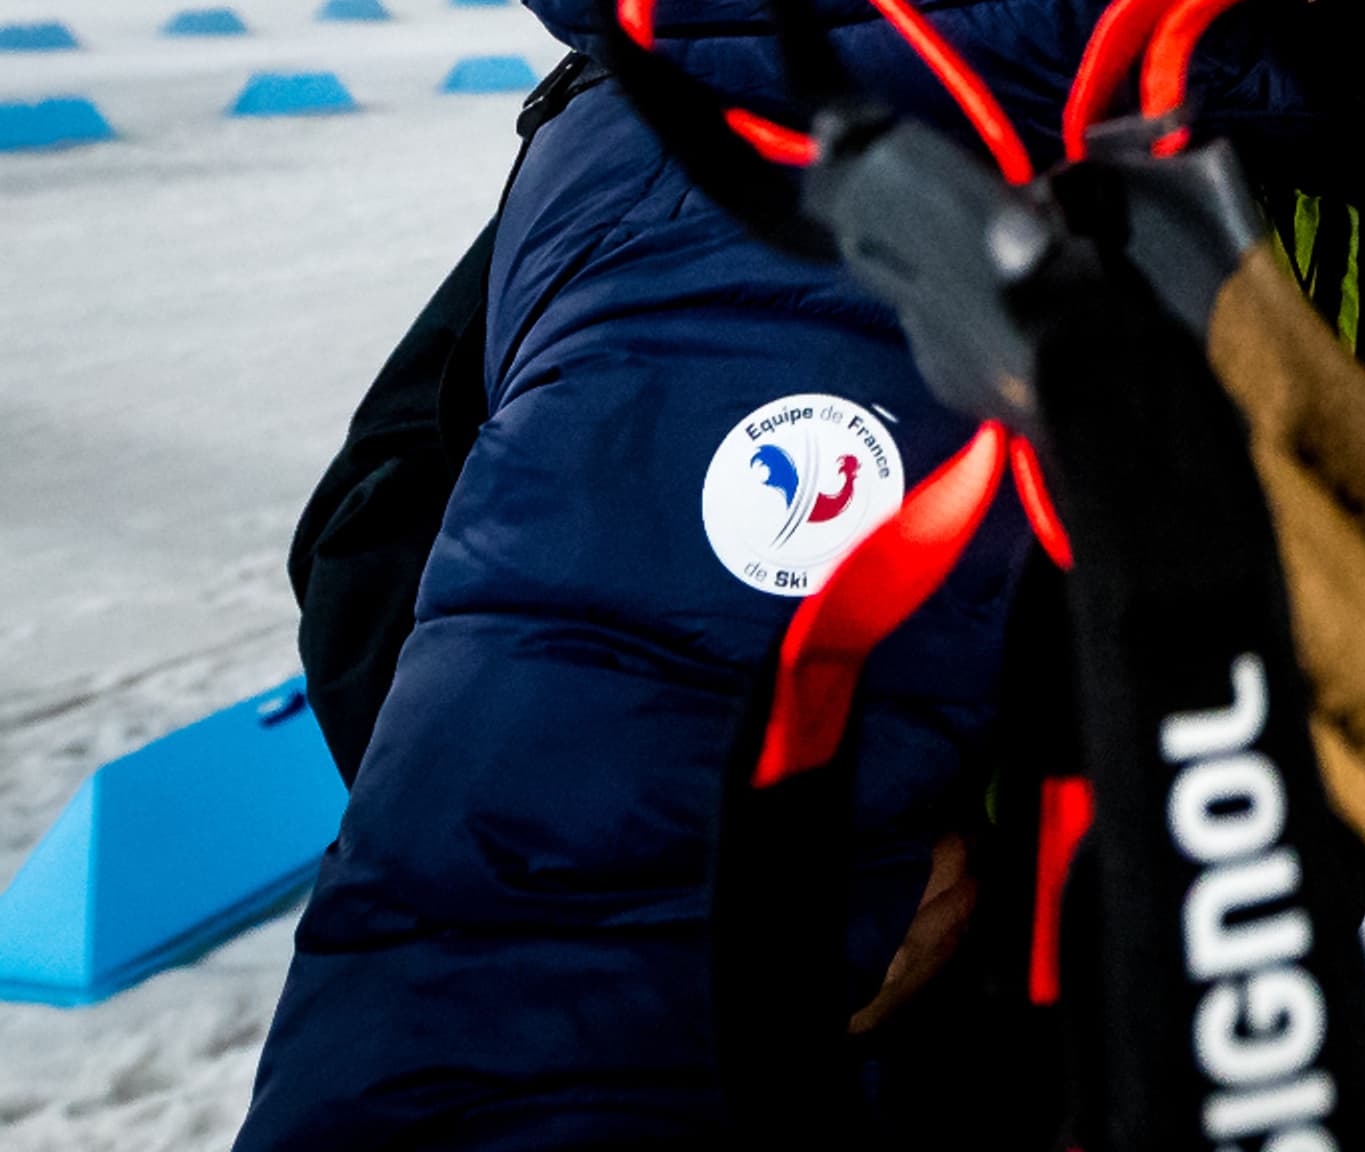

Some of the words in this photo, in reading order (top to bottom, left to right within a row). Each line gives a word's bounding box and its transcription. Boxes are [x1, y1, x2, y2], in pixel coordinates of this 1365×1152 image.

[746, 407, 813, 441] Equipe
[820, 404, 844, 424] de
[848, 415, 890, 480] France
[744, 562, 768, 583] de
[775, 570, 808, 590] Ski
